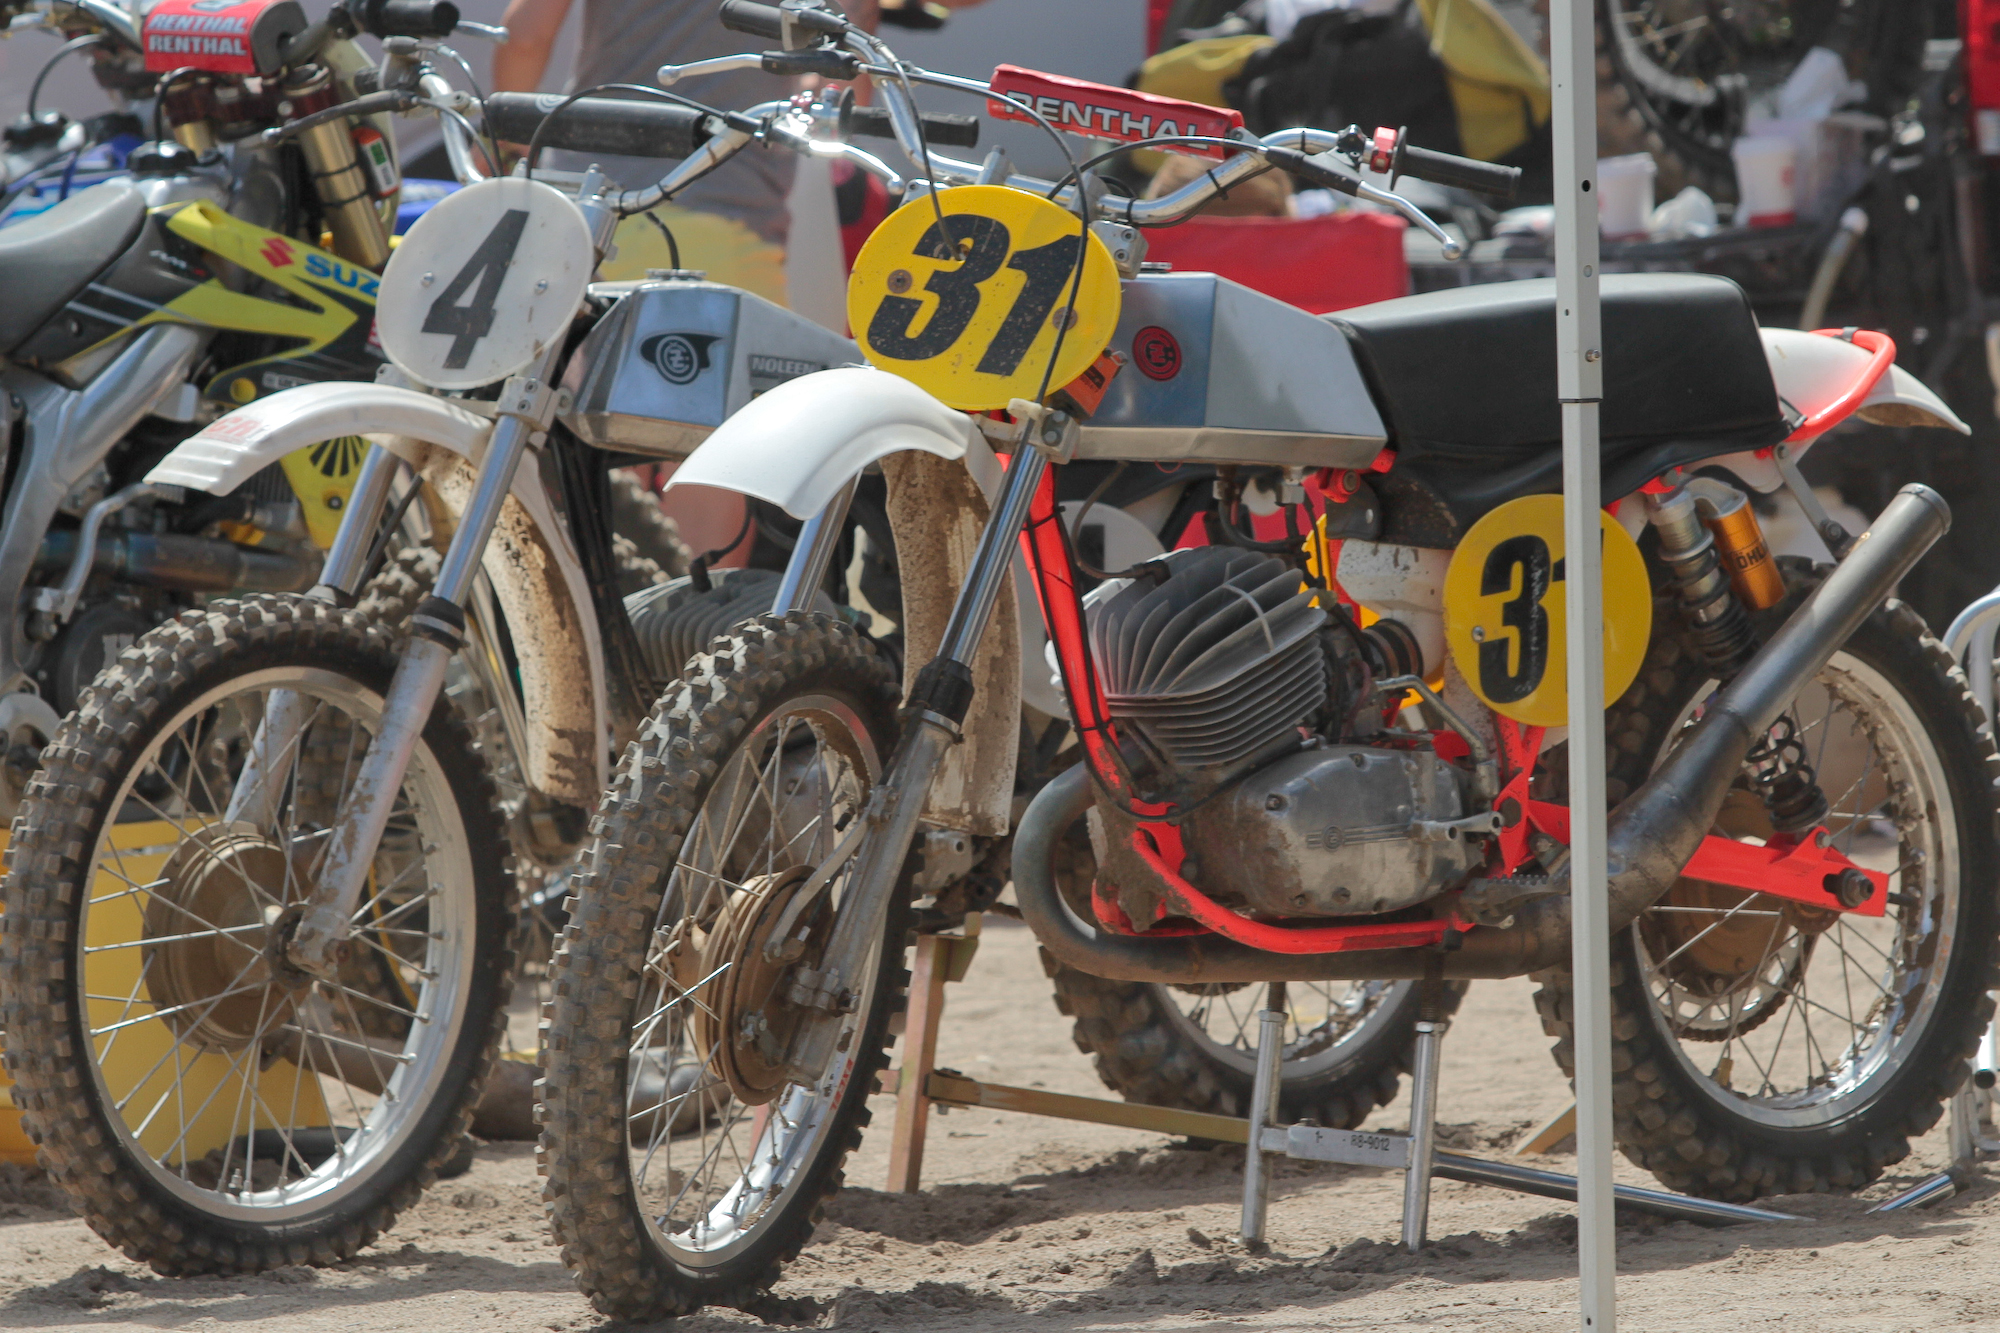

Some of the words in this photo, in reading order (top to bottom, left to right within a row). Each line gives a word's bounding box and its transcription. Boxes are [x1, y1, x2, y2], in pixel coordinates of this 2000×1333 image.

[148, 13, 247, 33] RENTHAL
[149, 34, 248, 56] RENTHAL
[1004, 90, 1210, 150] RENTHAL
[421, 209, 530, 369] 4
[867, 213, 1089, 377] 31
